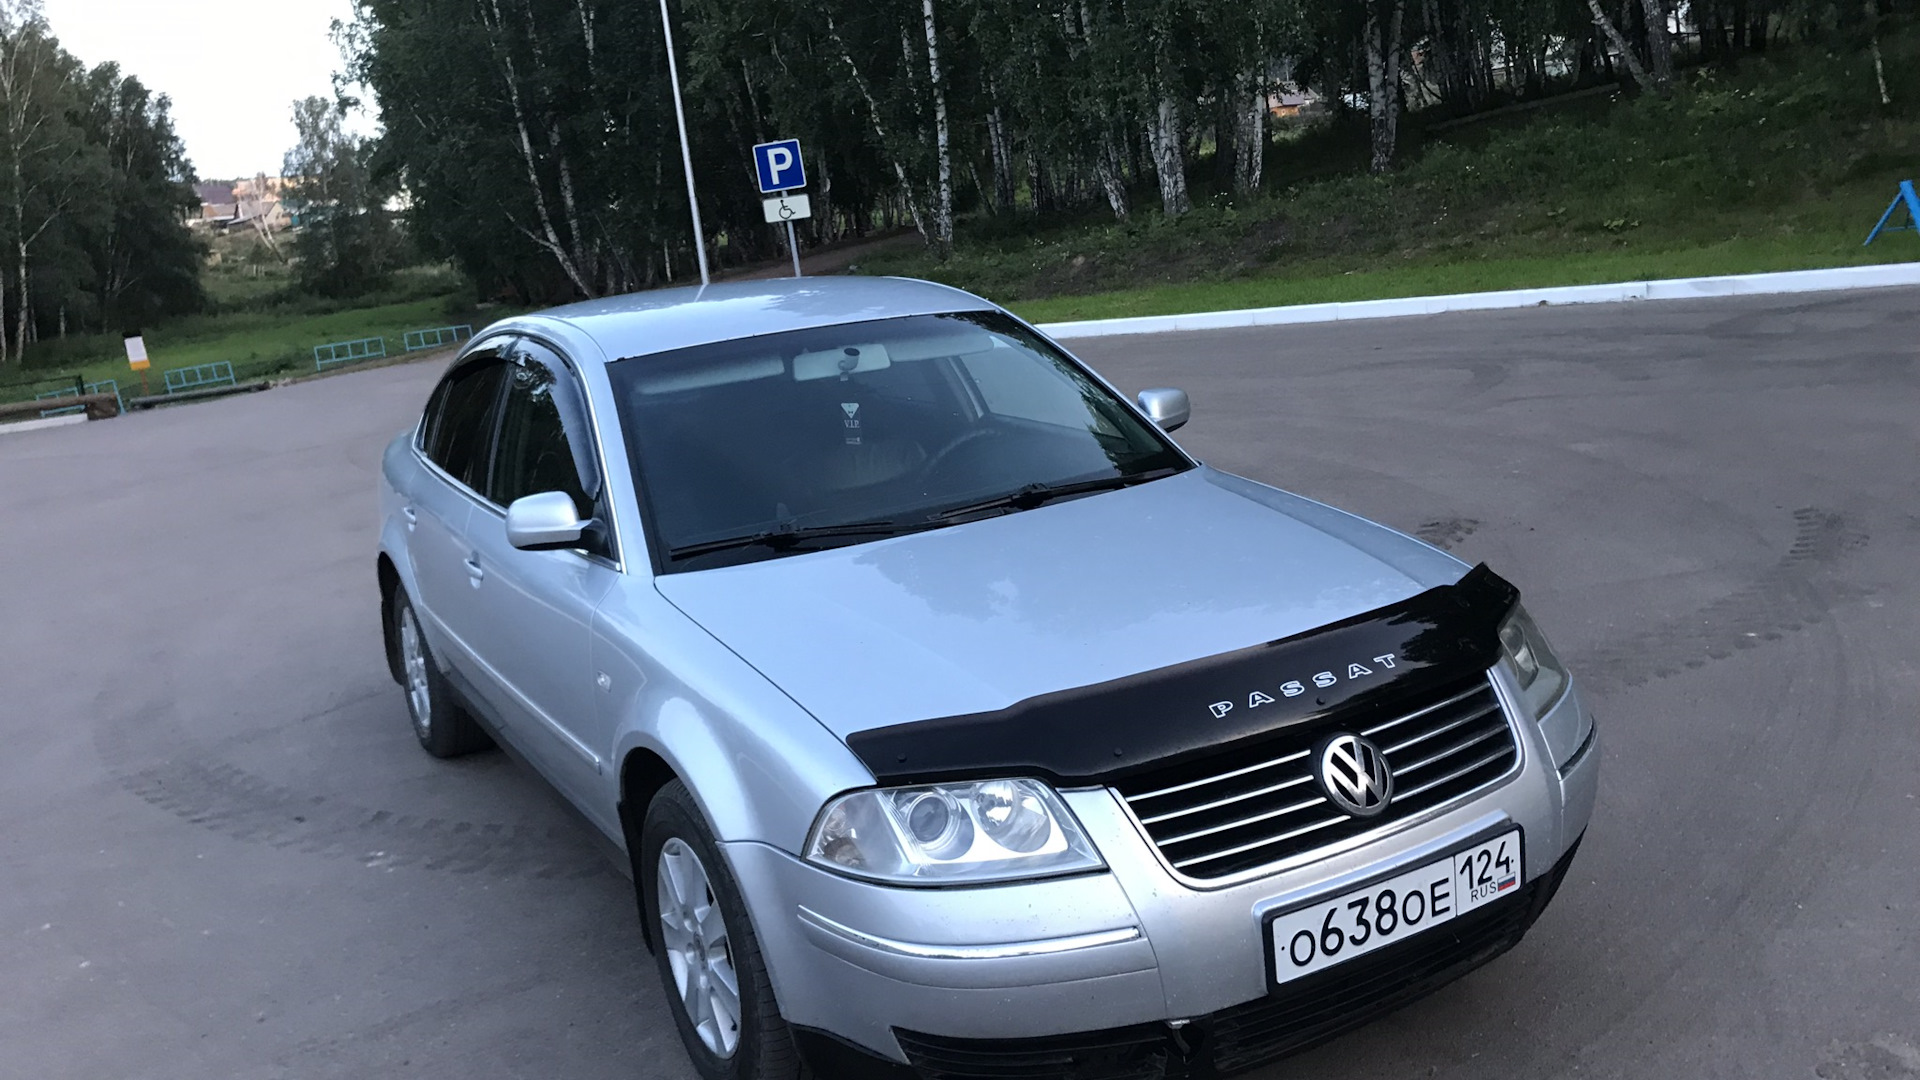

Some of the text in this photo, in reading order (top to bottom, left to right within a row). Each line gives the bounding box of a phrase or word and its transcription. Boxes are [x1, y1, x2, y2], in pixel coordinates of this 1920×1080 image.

[766, 147, 793, 186] P
[1208, 653, 1396, 719] PASSAT
[1459, 841, 1510, 890] 124
[1471, 881, 1497, 903] RUS
